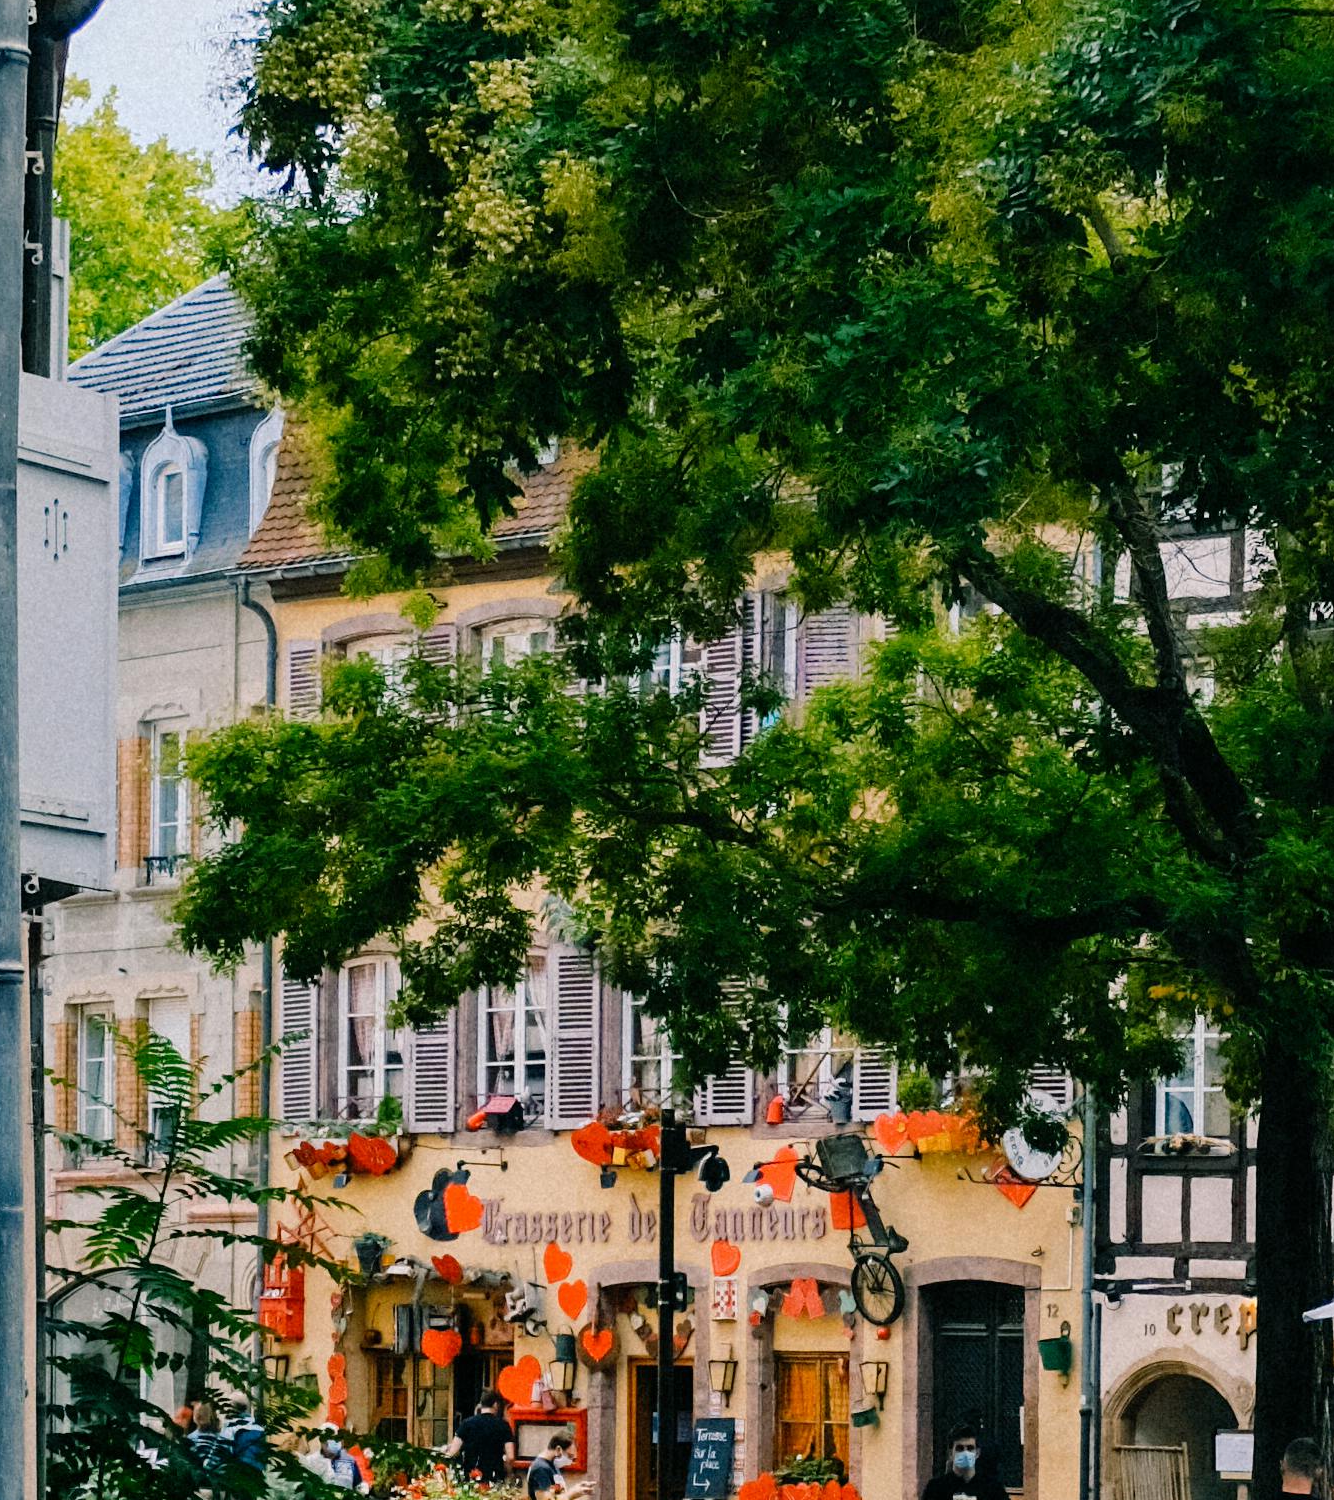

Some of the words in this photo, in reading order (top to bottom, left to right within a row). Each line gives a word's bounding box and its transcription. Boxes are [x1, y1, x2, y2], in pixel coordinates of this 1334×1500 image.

[629, 1192, 657, 1243] de
[690, 1193, 827, 1242] Tanneurs
[1047, 1304, 1059, 1318] 12
[1144, 1323, 1156, 1336] 10
